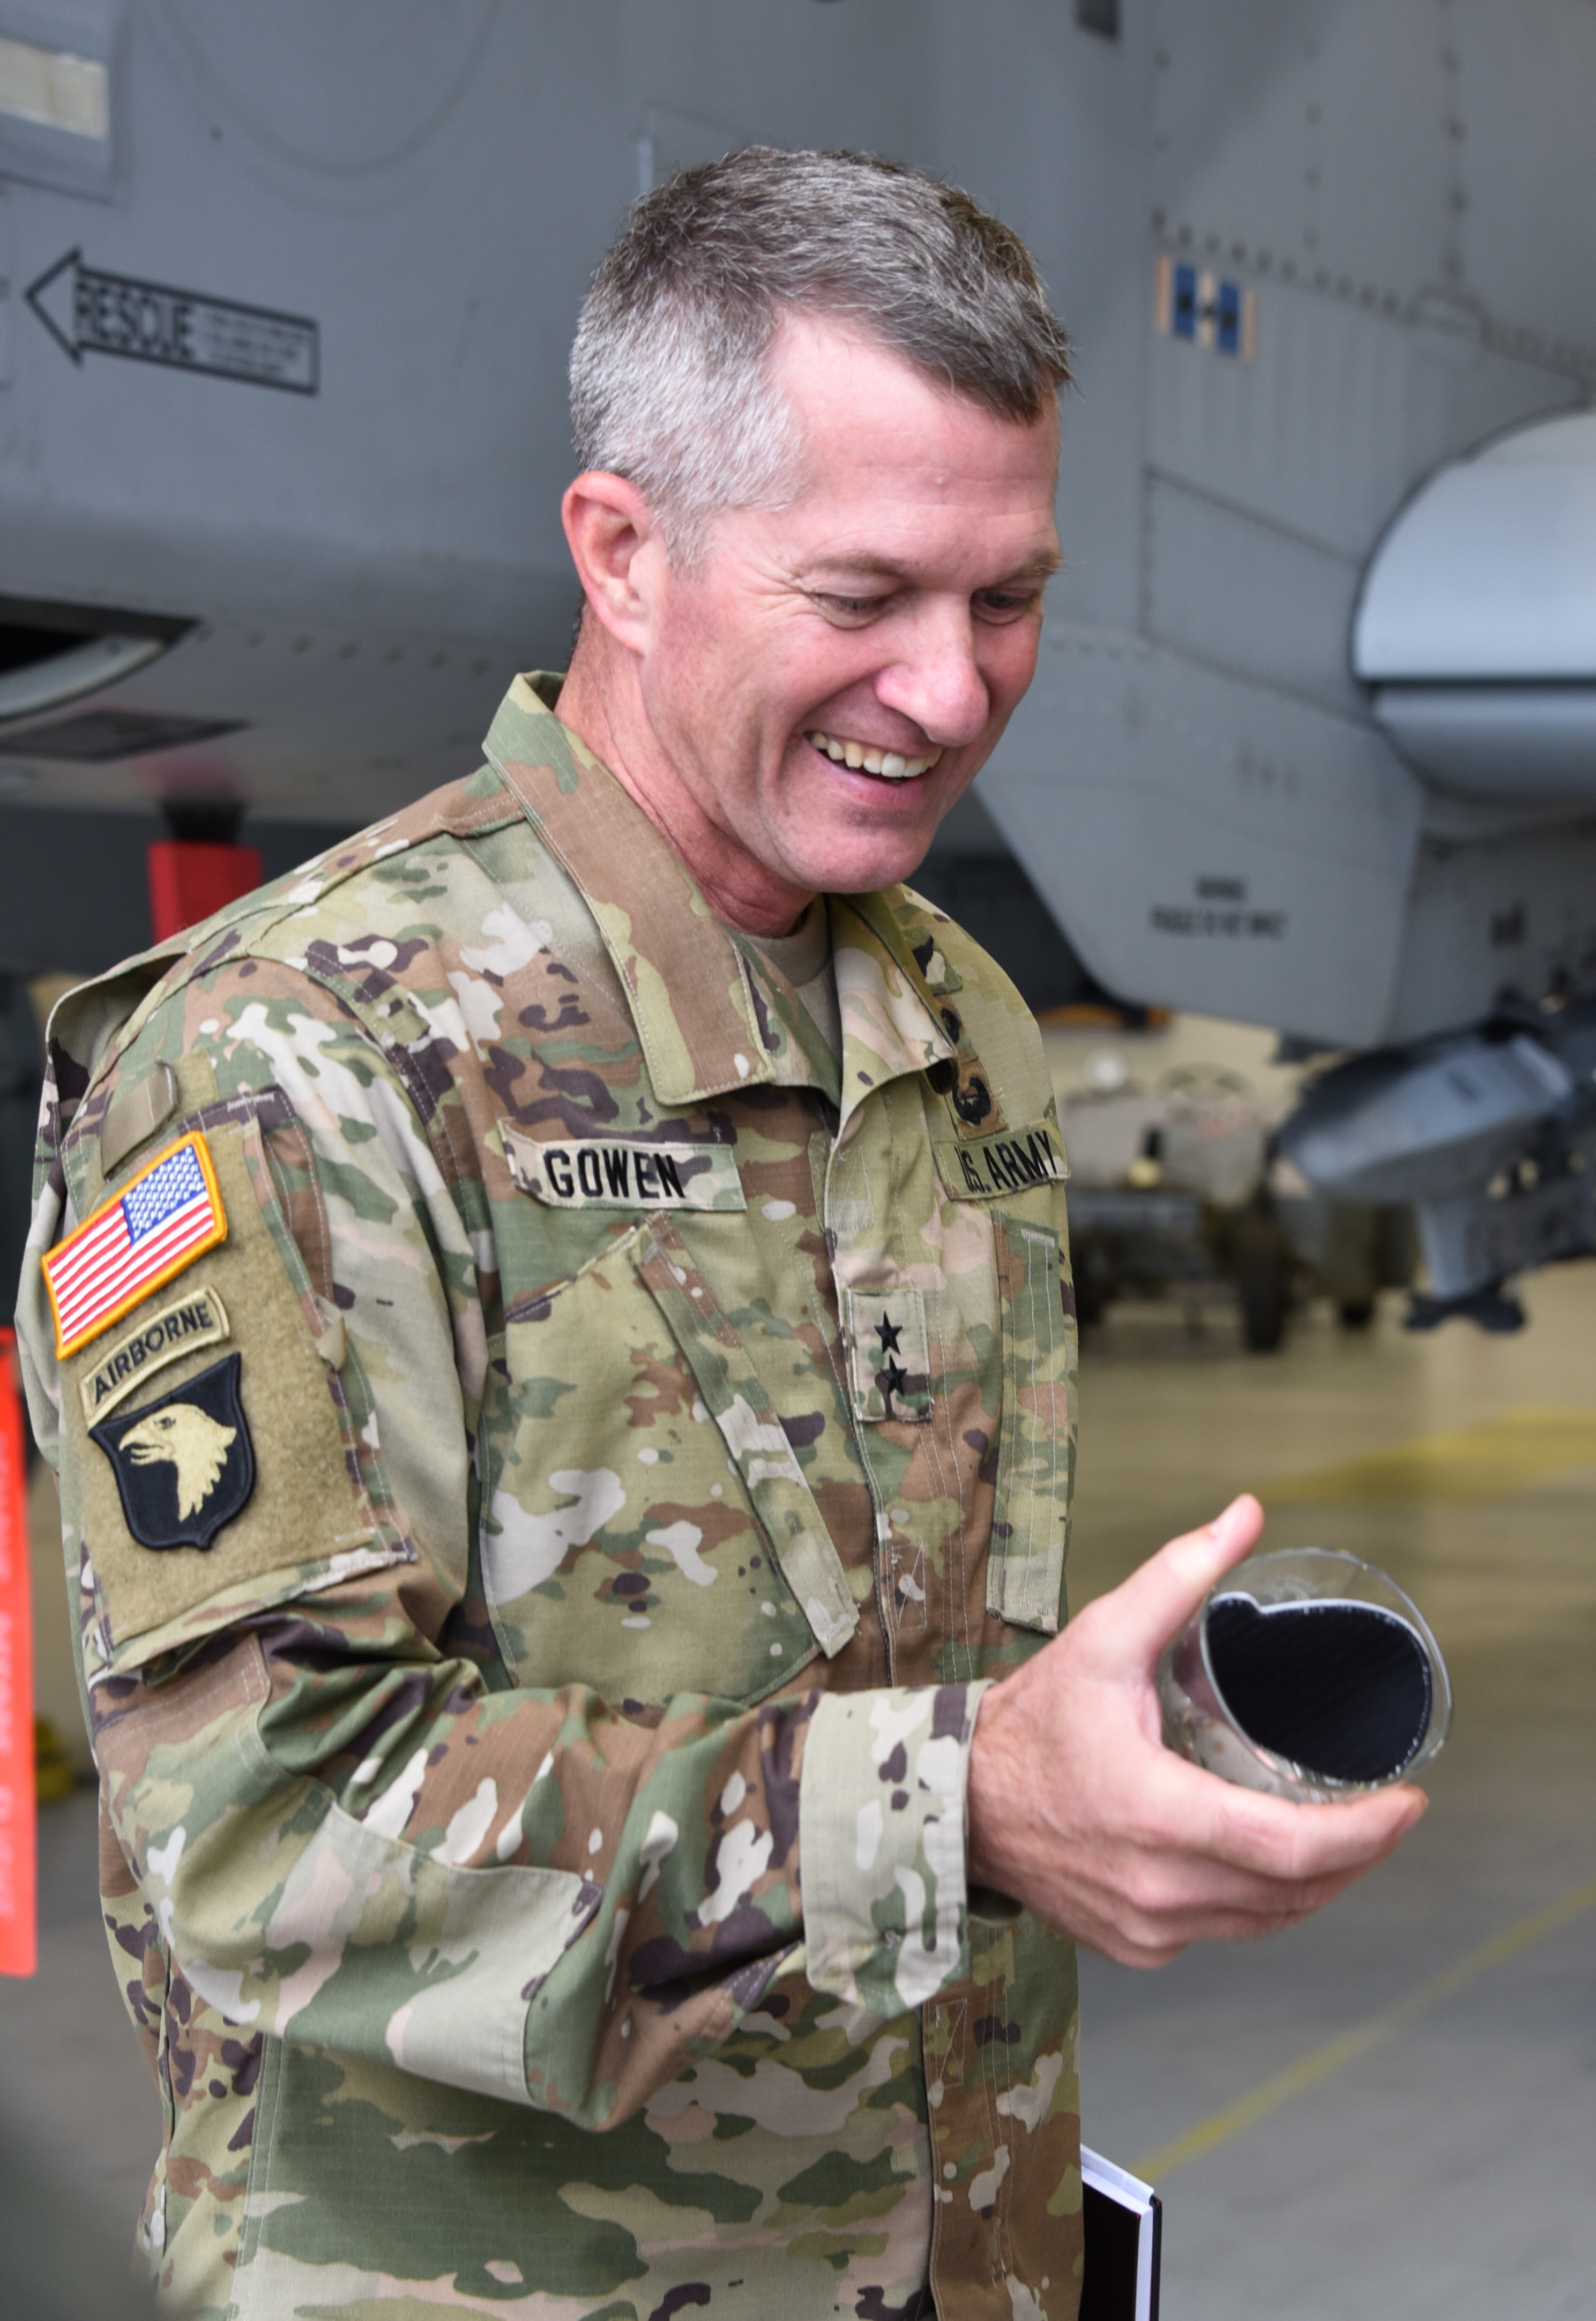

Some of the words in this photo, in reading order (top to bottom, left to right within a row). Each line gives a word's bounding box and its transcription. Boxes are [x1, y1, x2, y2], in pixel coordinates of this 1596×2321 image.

[76, 280, 193, 360] RESCUE
[543, 1148, 686, 1199] GOWEN
[982, 1129, 1057, 1191] ARMY
[94, 1302, 213, 1405] AIRBORNE
